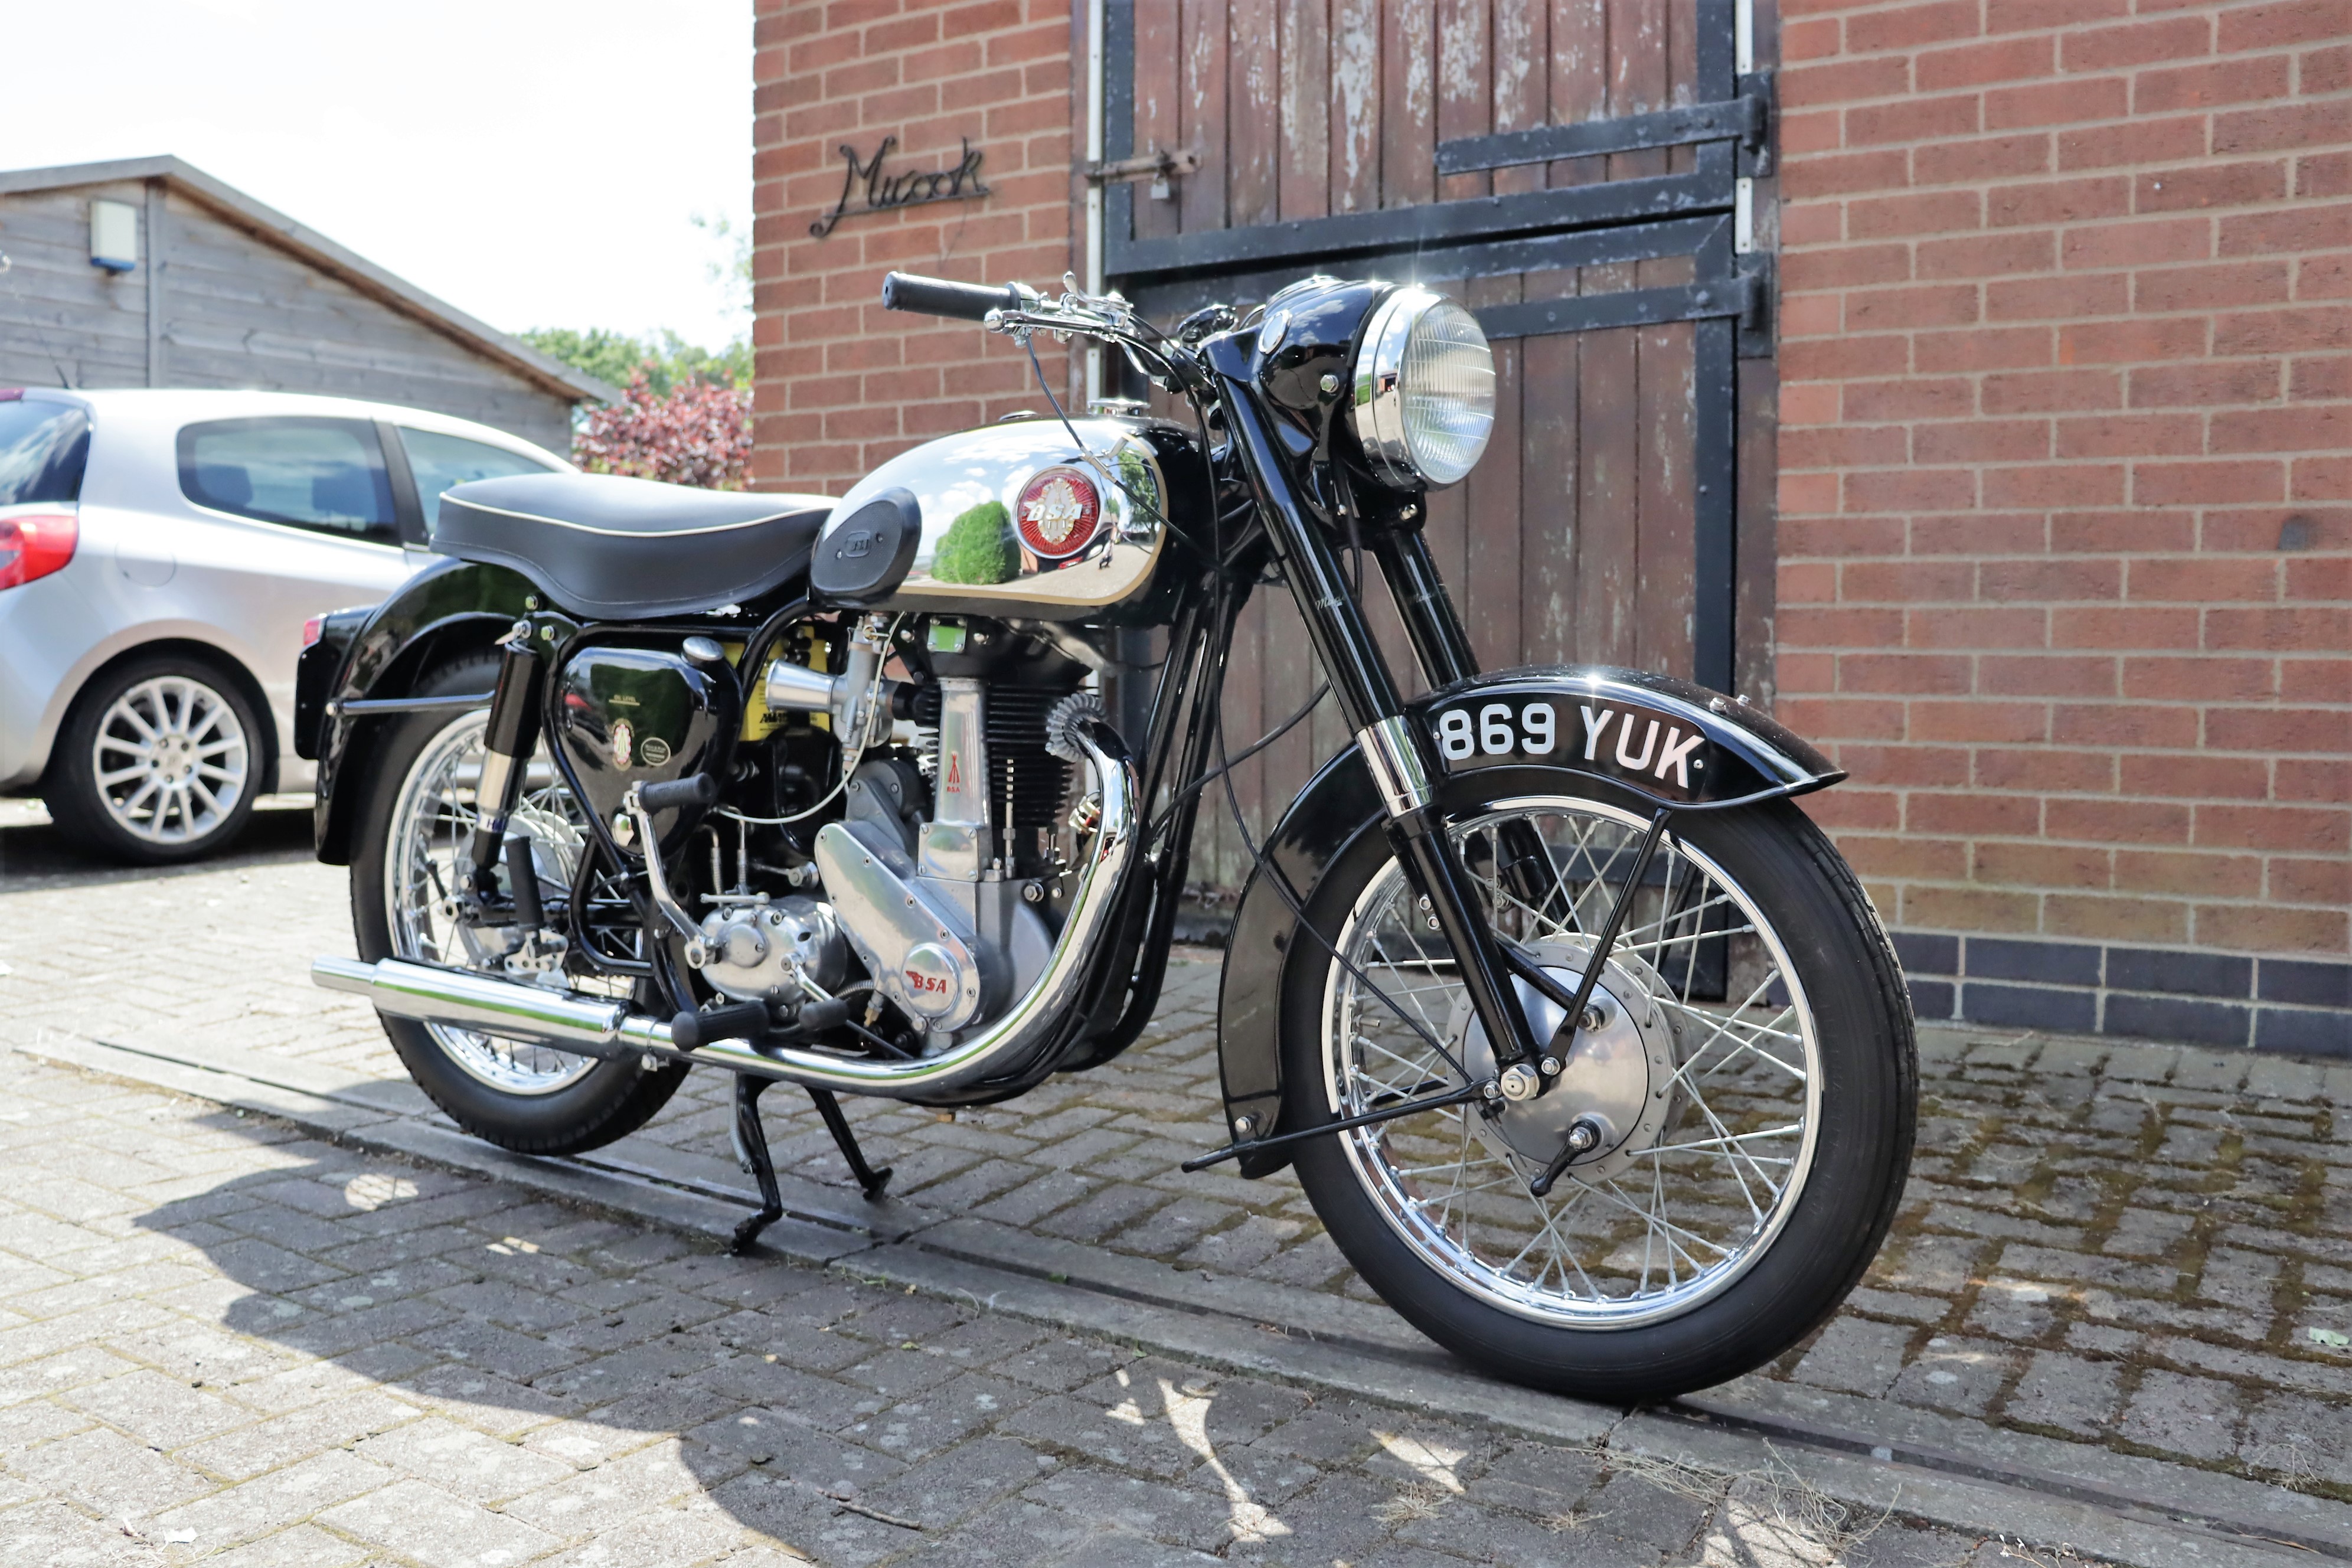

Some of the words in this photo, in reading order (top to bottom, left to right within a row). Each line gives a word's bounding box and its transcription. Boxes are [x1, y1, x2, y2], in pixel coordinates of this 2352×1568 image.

[1024, 502, 1083, 521] BSA
[1439, 703, 1556, 761] 869
[1580, 705, 1705, 789] YUK
[906, 971, 946, 994] BSA
